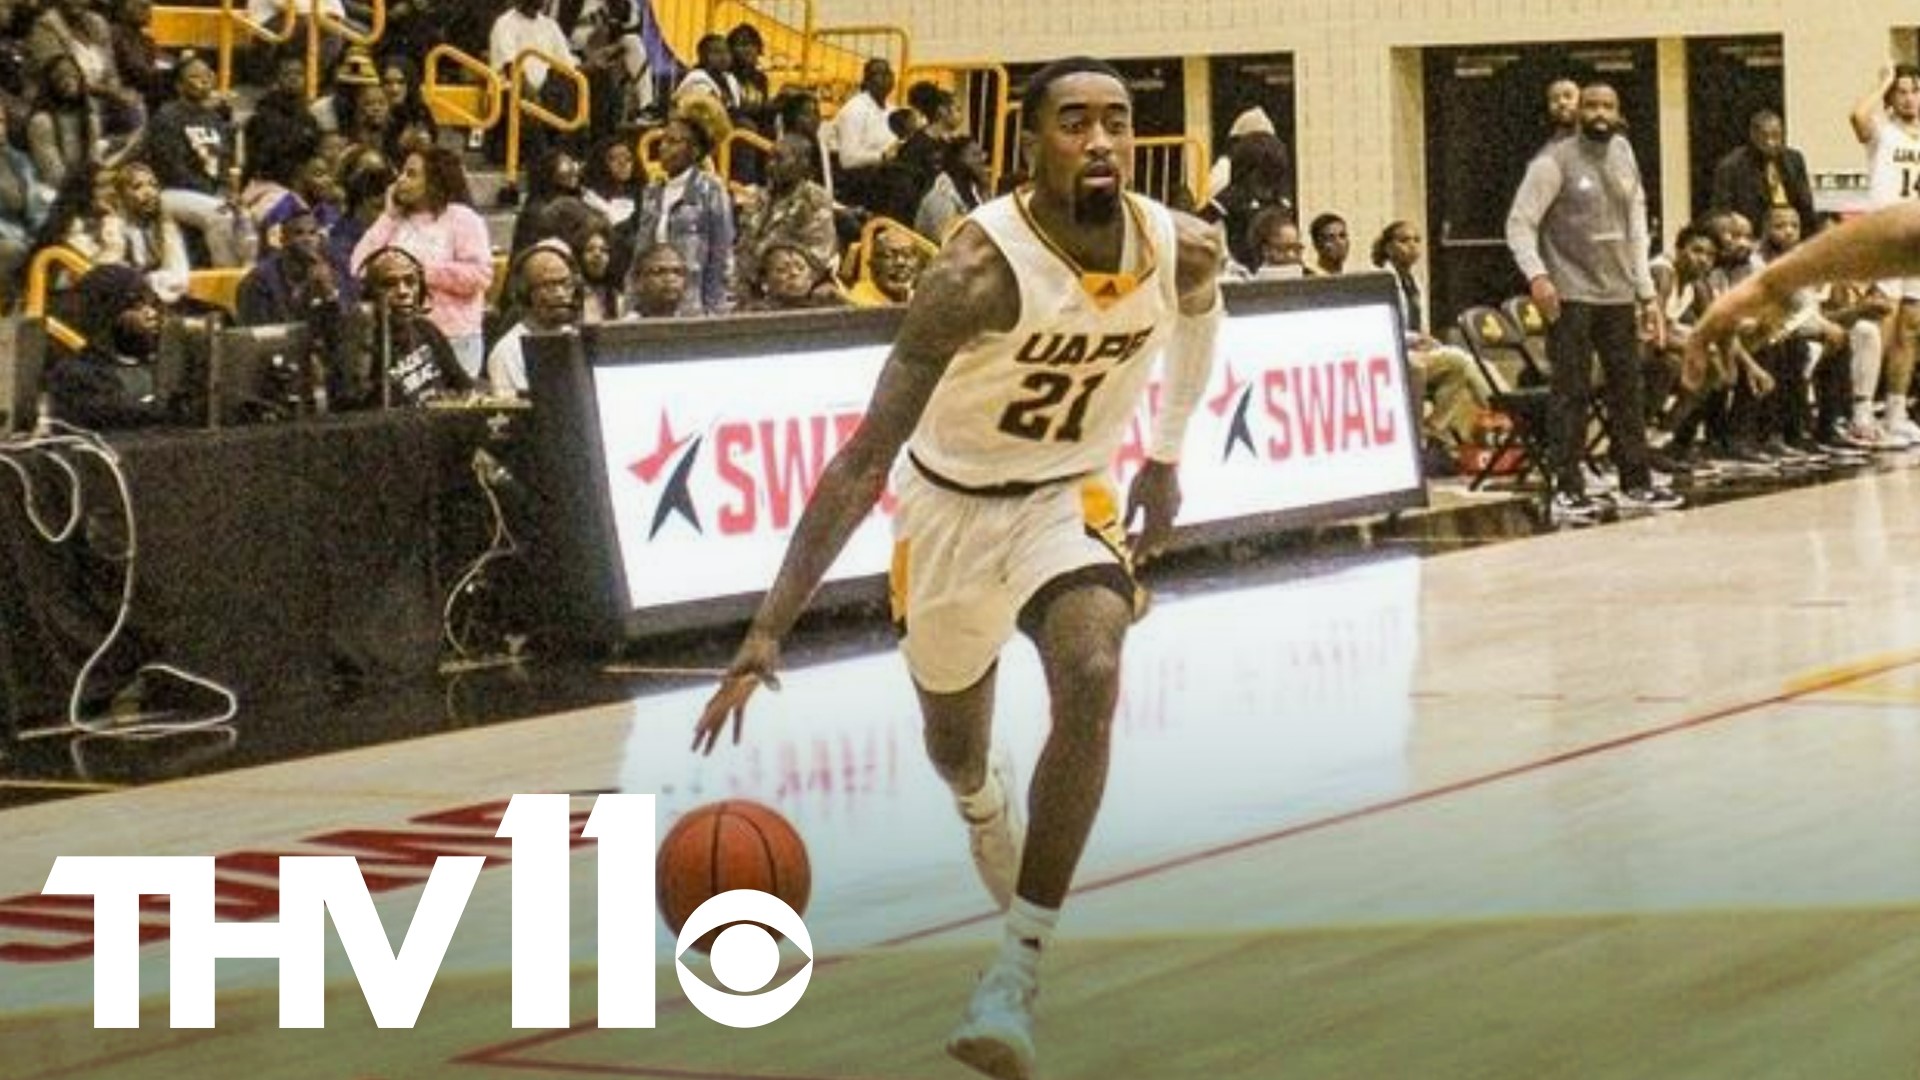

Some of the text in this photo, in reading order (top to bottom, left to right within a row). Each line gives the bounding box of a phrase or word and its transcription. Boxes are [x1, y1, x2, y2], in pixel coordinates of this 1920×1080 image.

[997, 371, 1107, 443] 21
[1264, 357, 1396, 460] SWAC
[715, 412, 898, 536] SW
